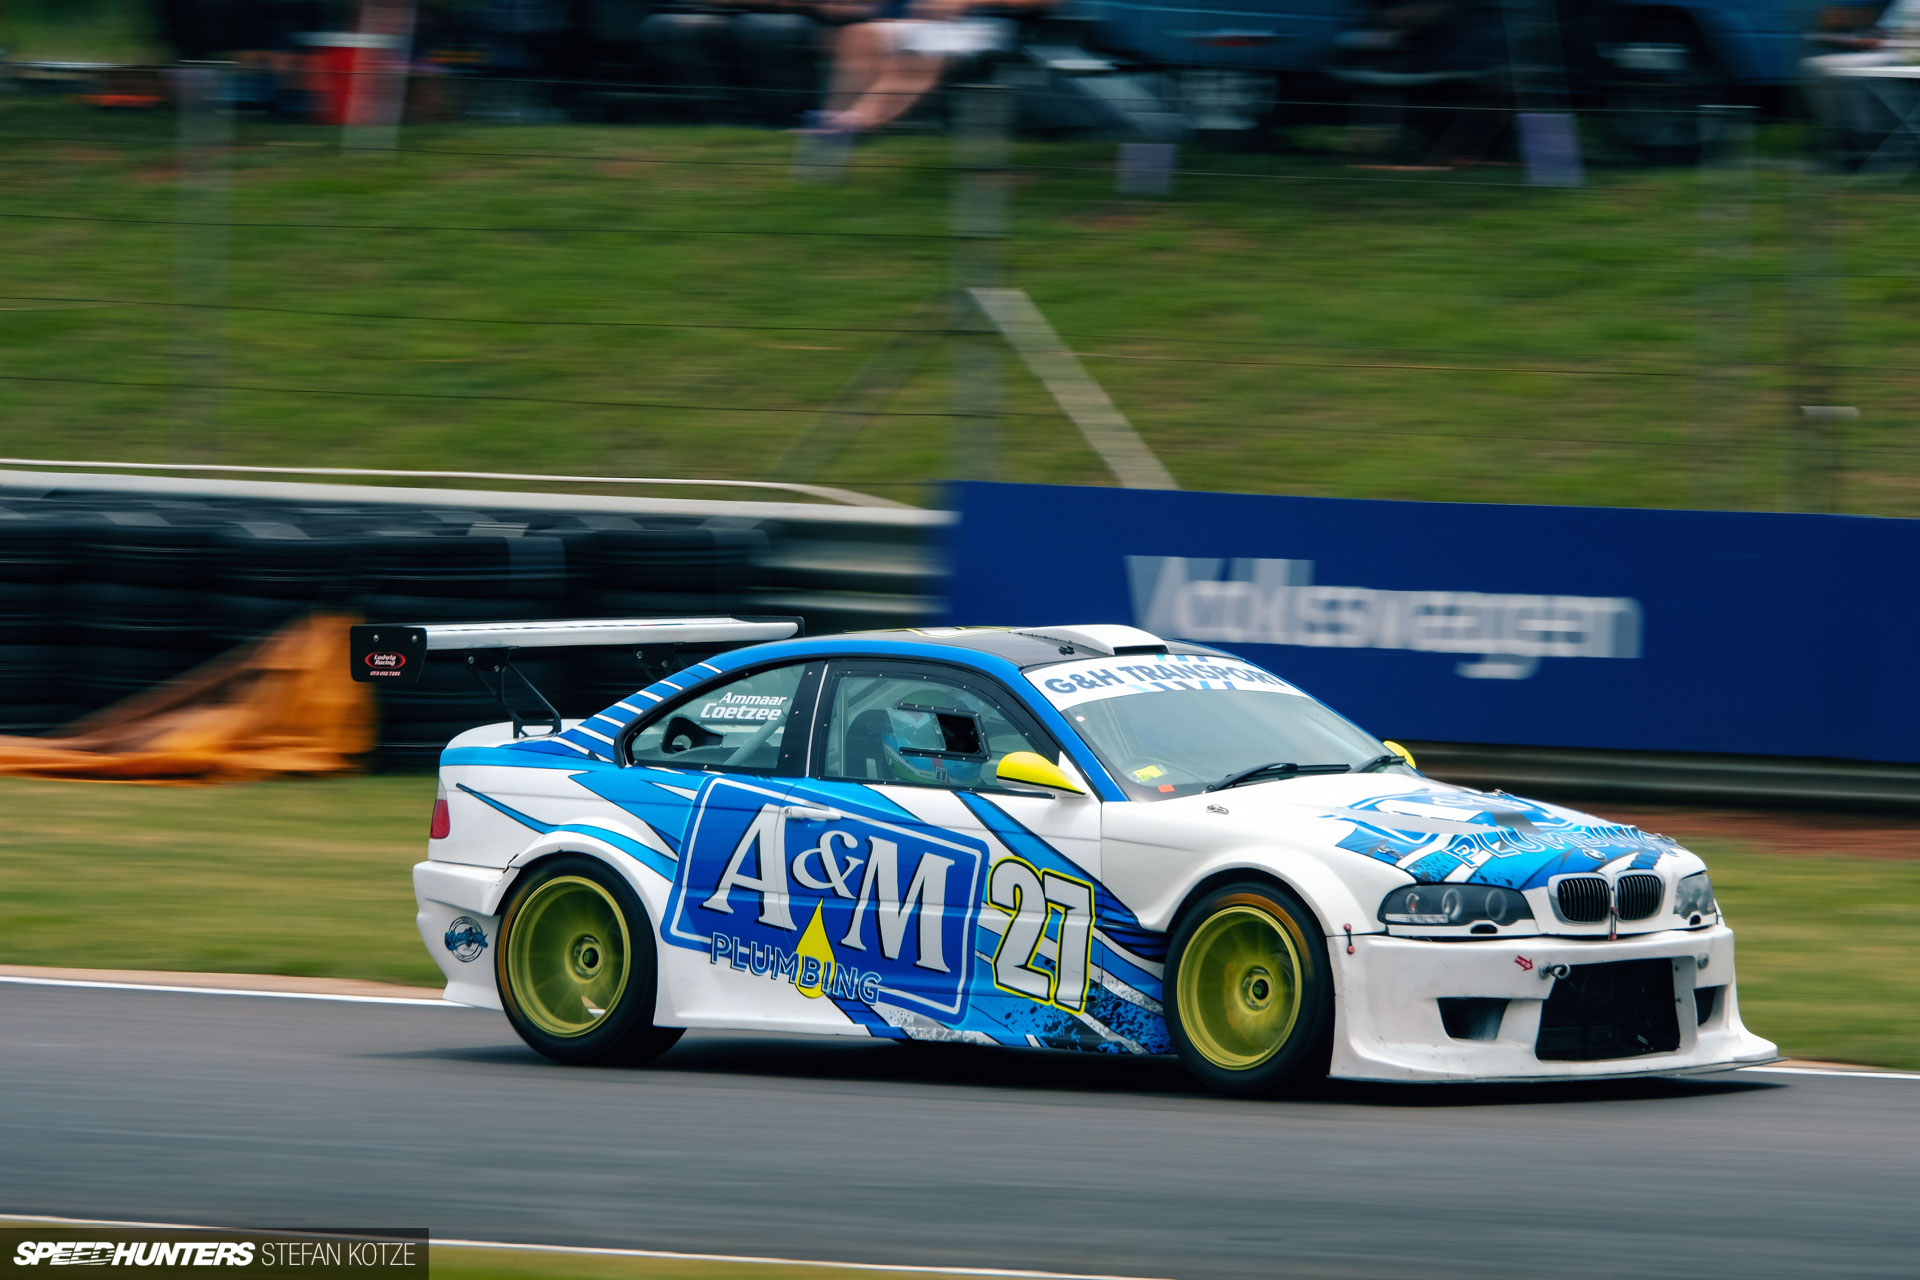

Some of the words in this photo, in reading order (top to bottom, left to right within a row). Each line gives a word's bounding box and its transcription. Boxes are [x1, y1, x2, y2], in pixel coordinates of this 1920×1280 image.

[719, 692, 787, 705] Ammaar
[1044, 669, 1125, 694] G&H
[1117, 664, 1287, 688] TRANSPORT
[700, 703, 782, 720] Coetzee
[702, 802, 956, 974] A&M
[987, 855, 1097, 1015] 27
[708, 931, 882, 1006] PLUMBING
